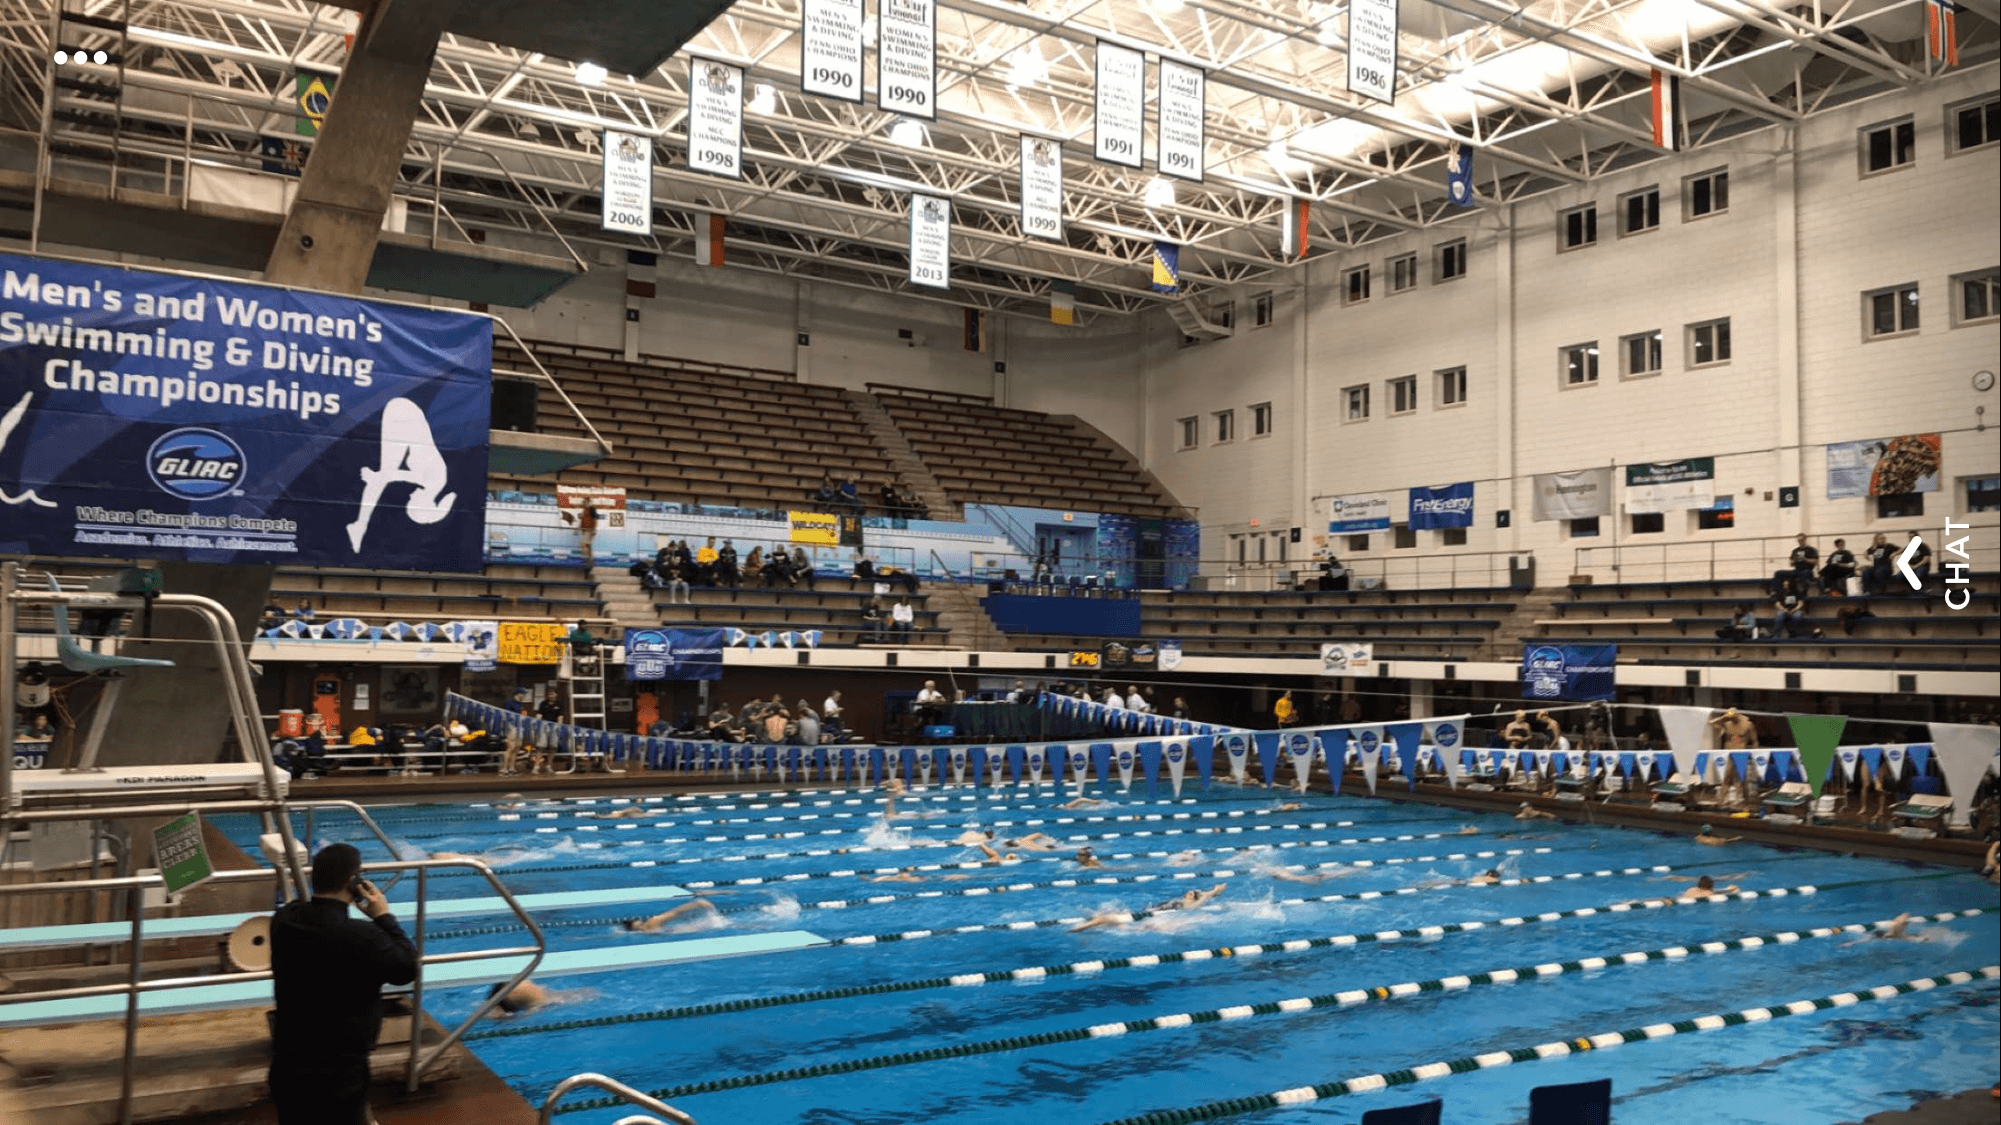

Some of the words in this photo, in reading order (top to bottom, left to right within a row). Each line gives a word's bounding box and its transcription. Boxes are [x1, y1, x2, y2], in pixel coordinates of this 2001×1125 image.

[806, 14, 860, 33] SWIMMING
[812, 25, 819, 33] &
[820, 26, 854, 41] DIVING
[1362, 25, 1390, 42] DIVING
[810, 39, 831, 49] PENN
[833, 43, 856, 54] OHIO
[882, 34, 931, 51] SWIMMING
[807, 46, 858, 63] CHAMPIONS
[887, 44, 894, 52] &
[895, 45, 927, 60] DIVING
[883, 65, 931, 81] CHAMPIONS
[885, 57, 906, 68] PENN
[907, 61, 928, 72] OHIO
[813, 67, 853, 88] 1990
[1356, 66, 1386, 90] 1986
[888, 85, 926, 106] 1990
[696, 103, 738, 118] SWIMMING
[707, 113, 732, 125] DIVING
[693, 132, 738, 147] CHAMPIONS
[1105, 137, 1133, 155] 1991
[698, 149, 734, 168] 1998
[1167, 152, 1194, 169] 1991
[610, 211, 644, 227] 2006
[1029, 216, 1056, 231] 1999
[916, 266, 943, 280] 2013
[3, 269, 122, 309] Men's
[135, 292, 205, 323] and
[216, 296, 383, 342] Women's
[0, 311, 214, 370] Swimming
[226, 338, 251, 365] &
[263, 341, 374, 387] Diving
[44, 359, 340, 419] Championships
[157, 457, 239, 480] GLIAC
[76, 506, 134, 524] Where
[136, 509, 227, 529] Champions
[228, 514, 297, 534] Compete
[504, 624, 560, 643] EAGLE
